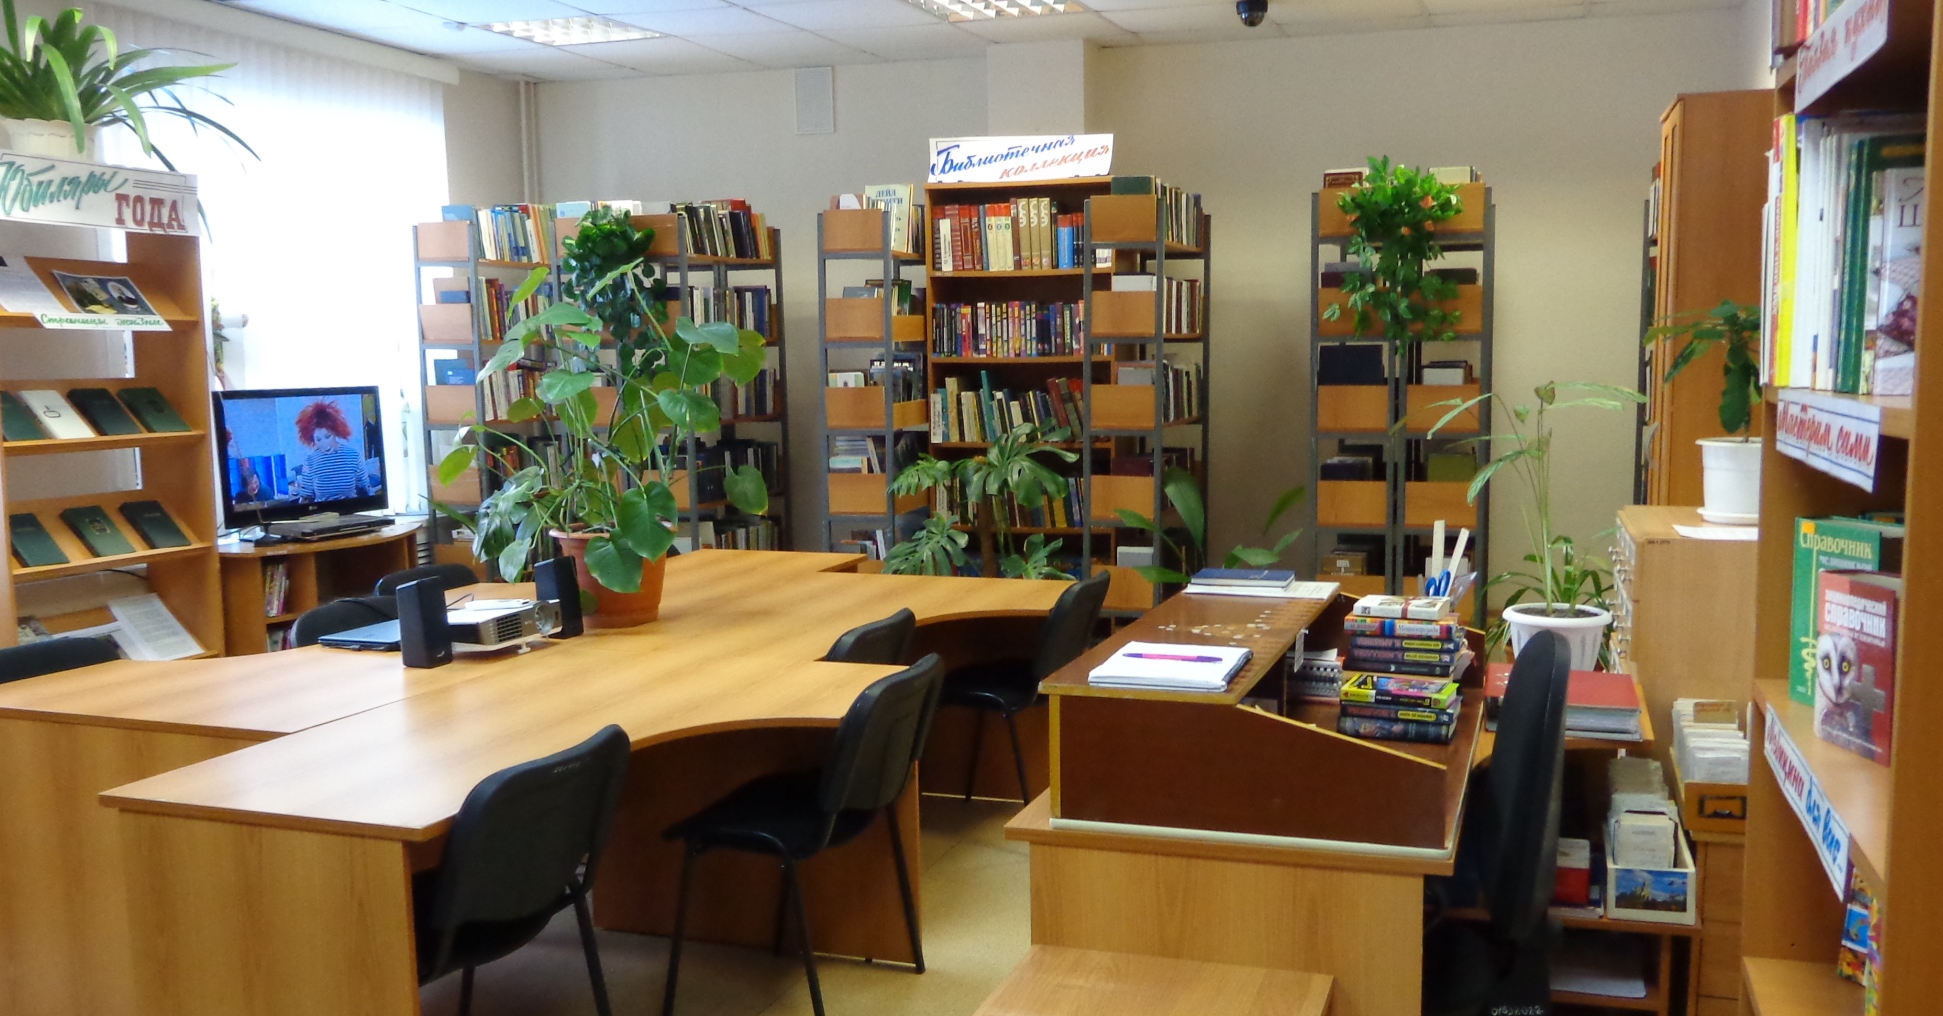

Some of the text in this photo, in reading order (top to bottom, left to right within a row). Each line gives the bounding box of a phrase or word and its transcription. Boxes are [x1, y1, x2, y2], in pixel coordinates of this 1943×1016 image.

[930, 135, 1075, 177] Библиотечная
[999, 144, 1110, 179] коллекция
[115, 193, 188, 233] ГОДА
[41, 313, 109, 328] Страницы
